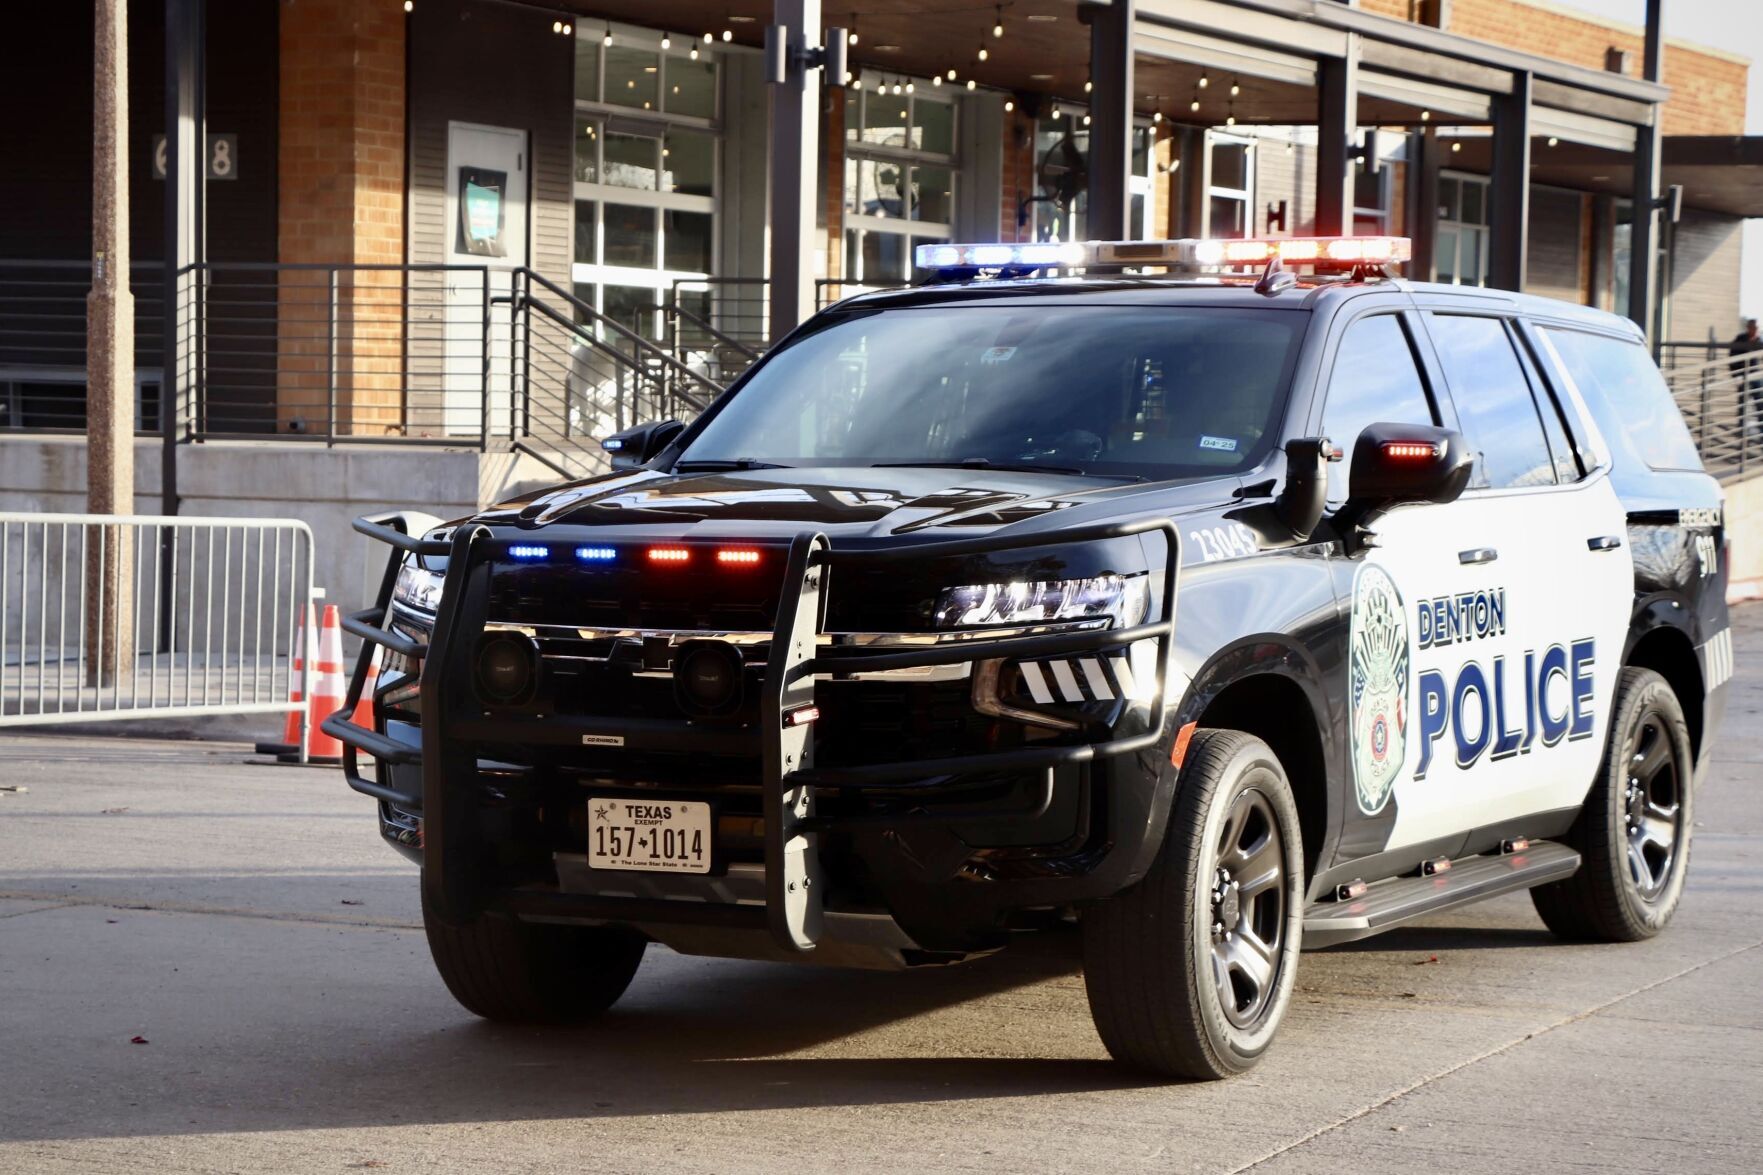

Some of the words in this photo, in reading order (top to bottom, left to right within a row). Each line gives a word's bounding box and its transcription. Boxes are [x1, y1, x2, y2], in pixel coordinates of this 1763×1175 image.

[1190, 523, 1257, 560] 23045
[1417, 587, 1505, 649] DENTON
[1413, 636, 1595, 781] POLICE
[625, 805, 672, 820] TEXAS
